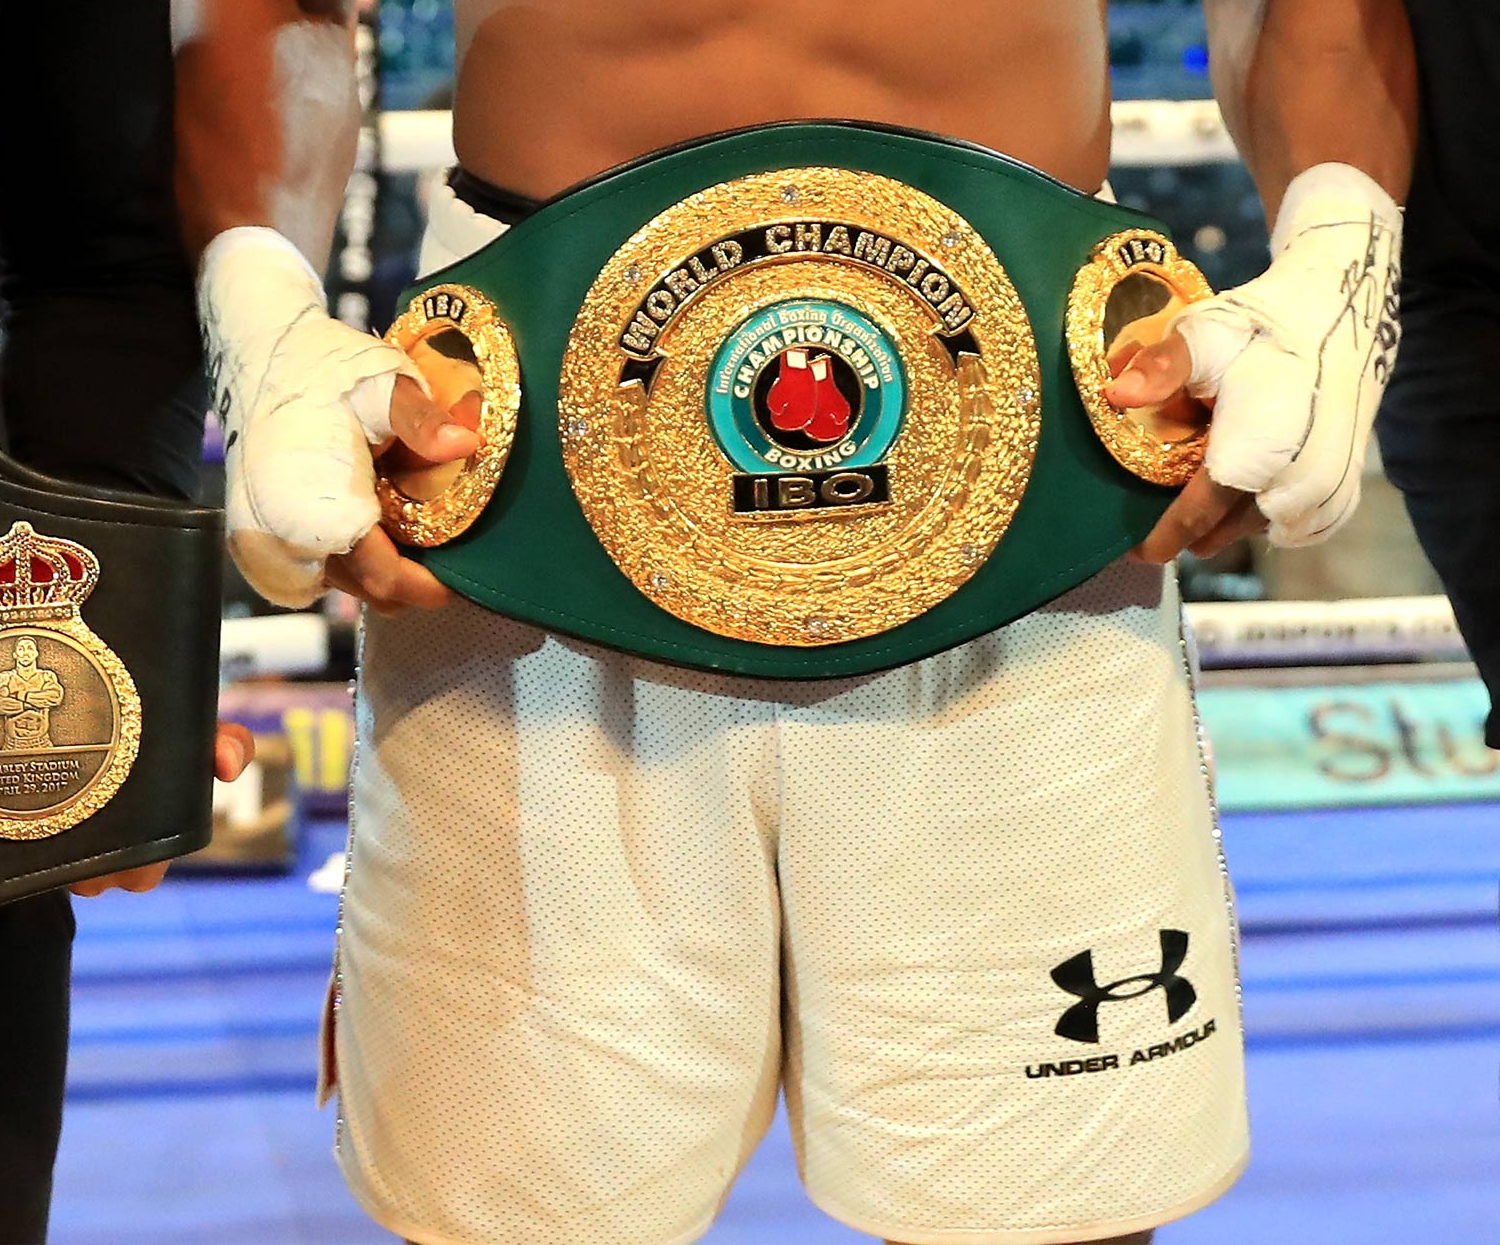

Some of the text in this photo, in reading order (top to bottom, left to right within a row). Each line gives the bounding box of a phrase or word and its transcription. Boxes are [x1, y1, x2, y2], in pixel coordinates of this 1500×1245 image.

[622, 223, 976, 352] WORLD CHAMPION
[425, 293, 464, 319] IBO
[716, 306, 893, 394] International Boxing Organization
[733, 325, 880, 399] CHAMPIONSHIP
[764, 441, 858, 470] BOXING
[753, 472, 875, 509] IBO
[23, 772, 80, 783] KINGDOM
[30, 760, 80, 772] STADIUM
[41, 782, 68, 793] 2017
[1024, 1019, 1217, 1079] UNDER ARMOUR
